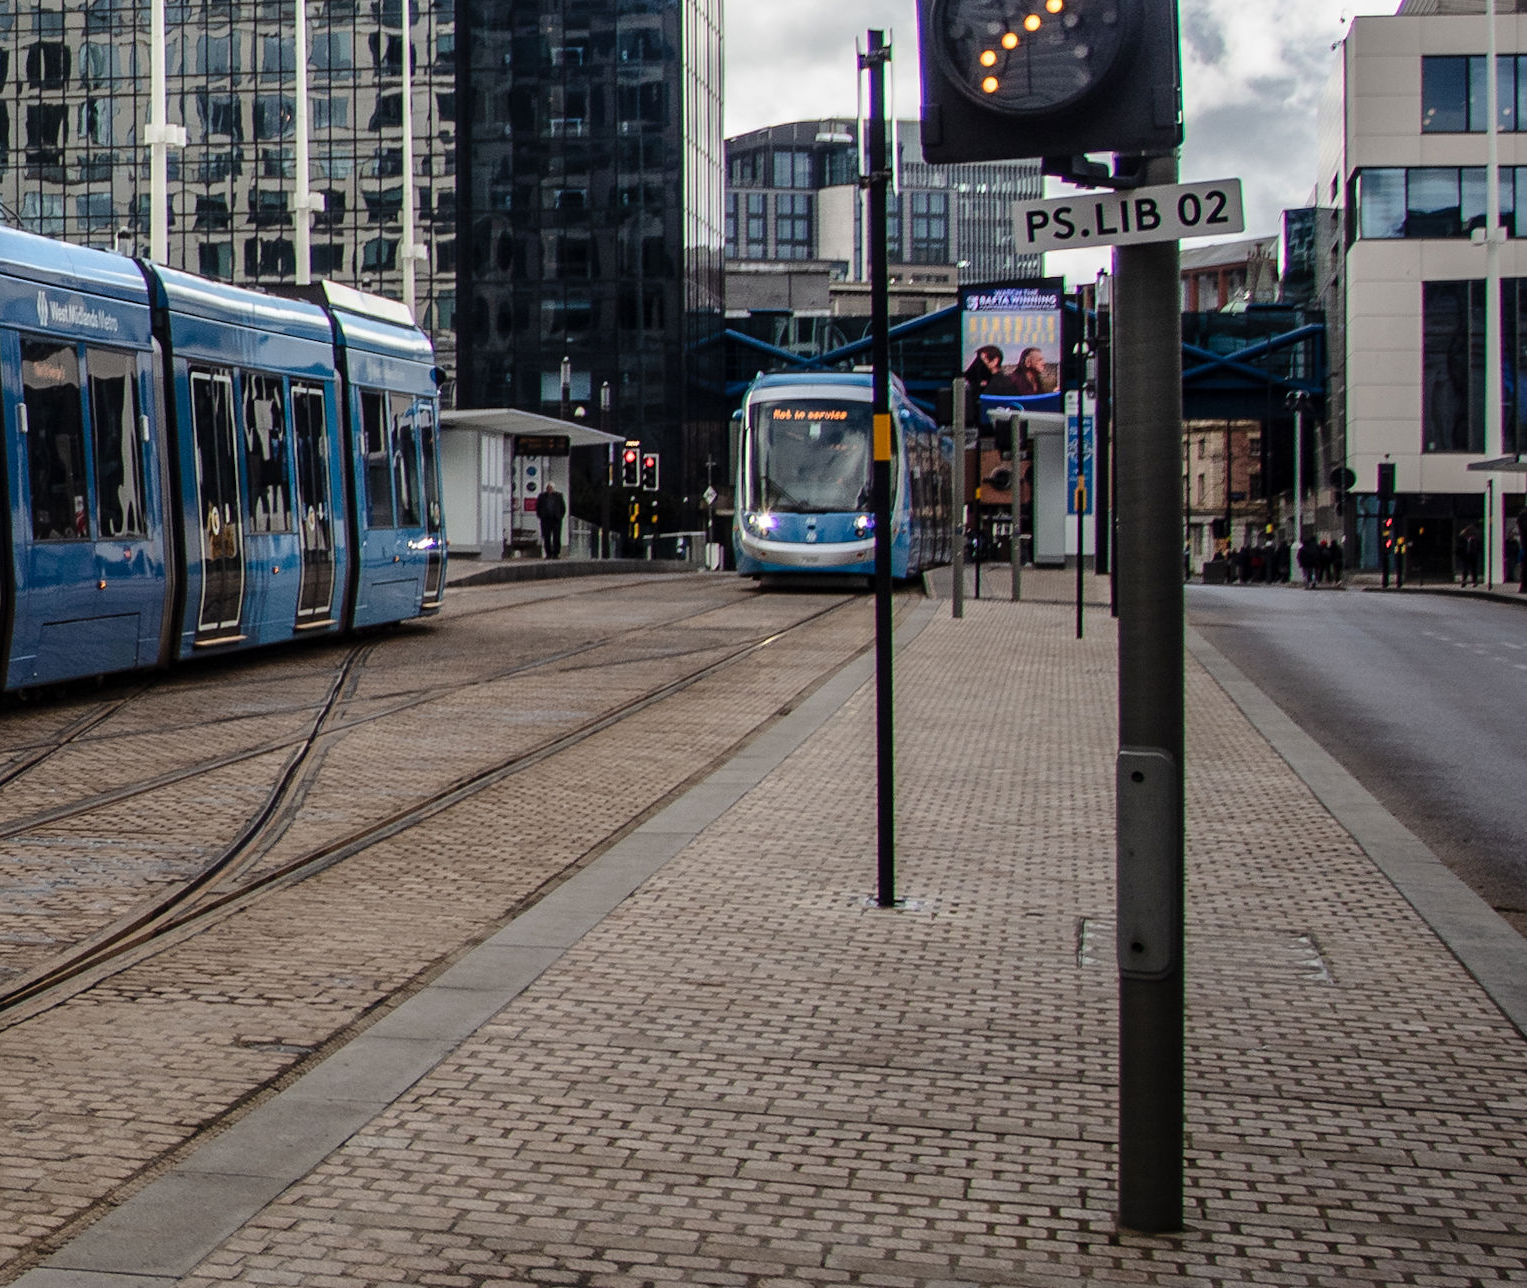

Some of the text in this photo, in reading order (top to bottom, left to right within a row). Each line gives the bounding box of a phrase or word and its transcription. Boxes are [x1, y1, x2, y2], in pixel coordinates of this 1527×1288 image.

[1026, 190, 1228, 243] PS.LIB 02
[1011, 295, 1058, 305] WINNING
[50, 301, 68, 322] West
[68, 304, 99, 328] Midlands
[773, 409, 792, 420] Not
[794, 410, 806, 420] in
